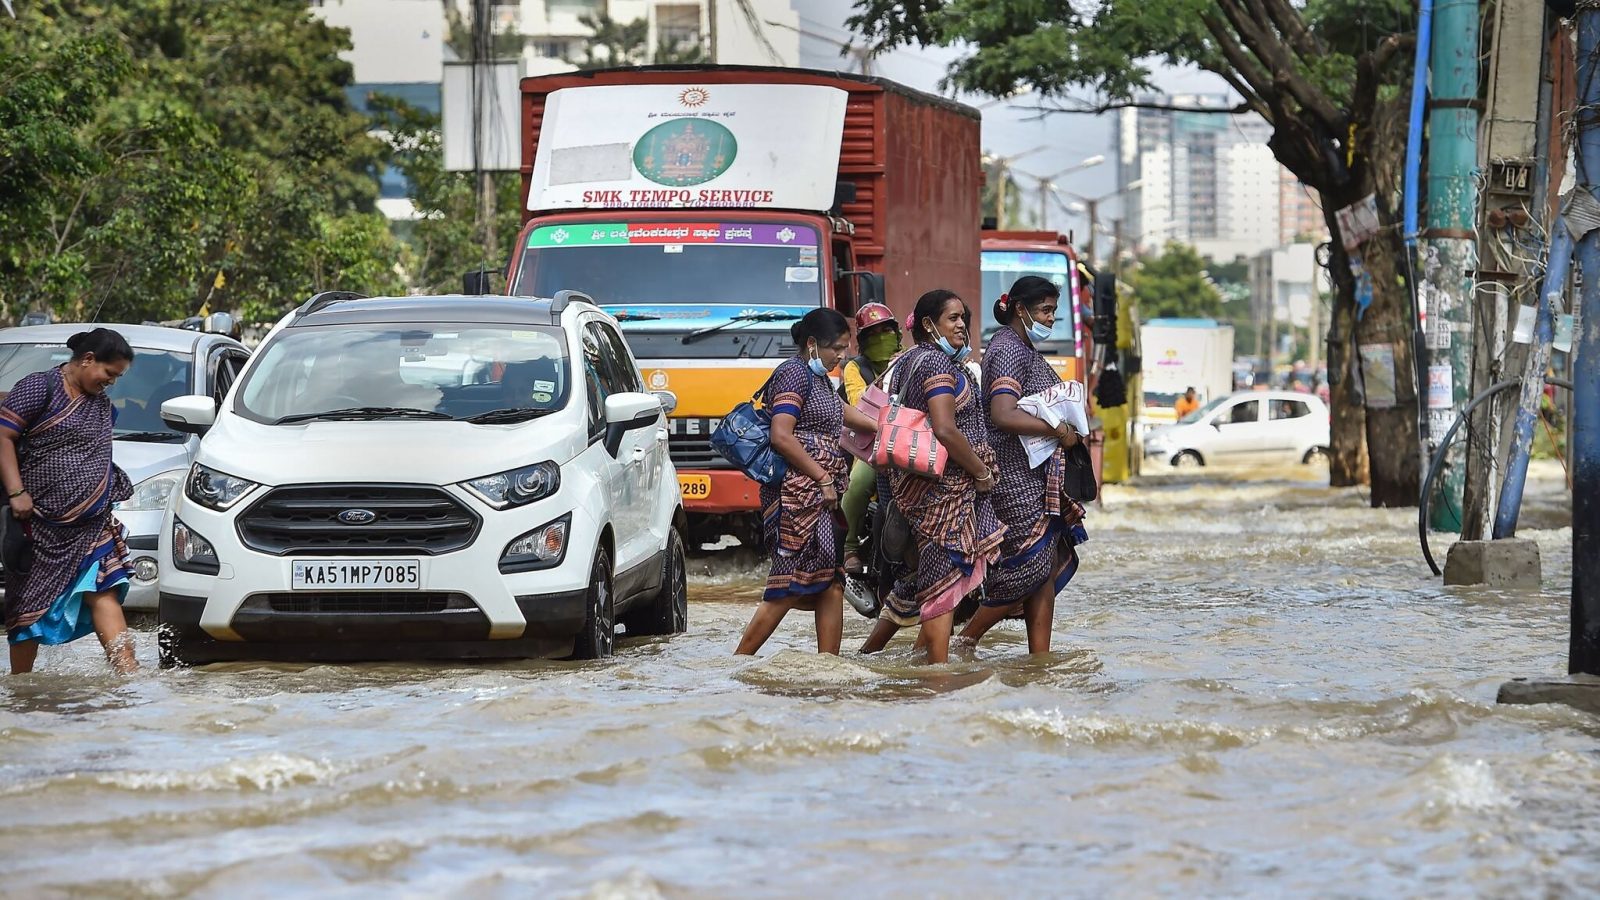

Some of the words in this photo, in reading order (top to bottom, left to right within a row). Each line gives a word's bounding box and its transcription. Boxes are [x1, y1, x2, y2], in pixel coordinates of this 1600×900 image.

[583, 190, 622, 203] SMK
[630, 190, 691, 203] TEMPO
[699, 190, 773, 203] SERVICE
[591, 228, 605, 240] ಶ್ರೀ
[679, 483, 706, 495] 289
[345, 511, 367, 521] Ford
[305, 566, 417, 584] KA51MP7085
